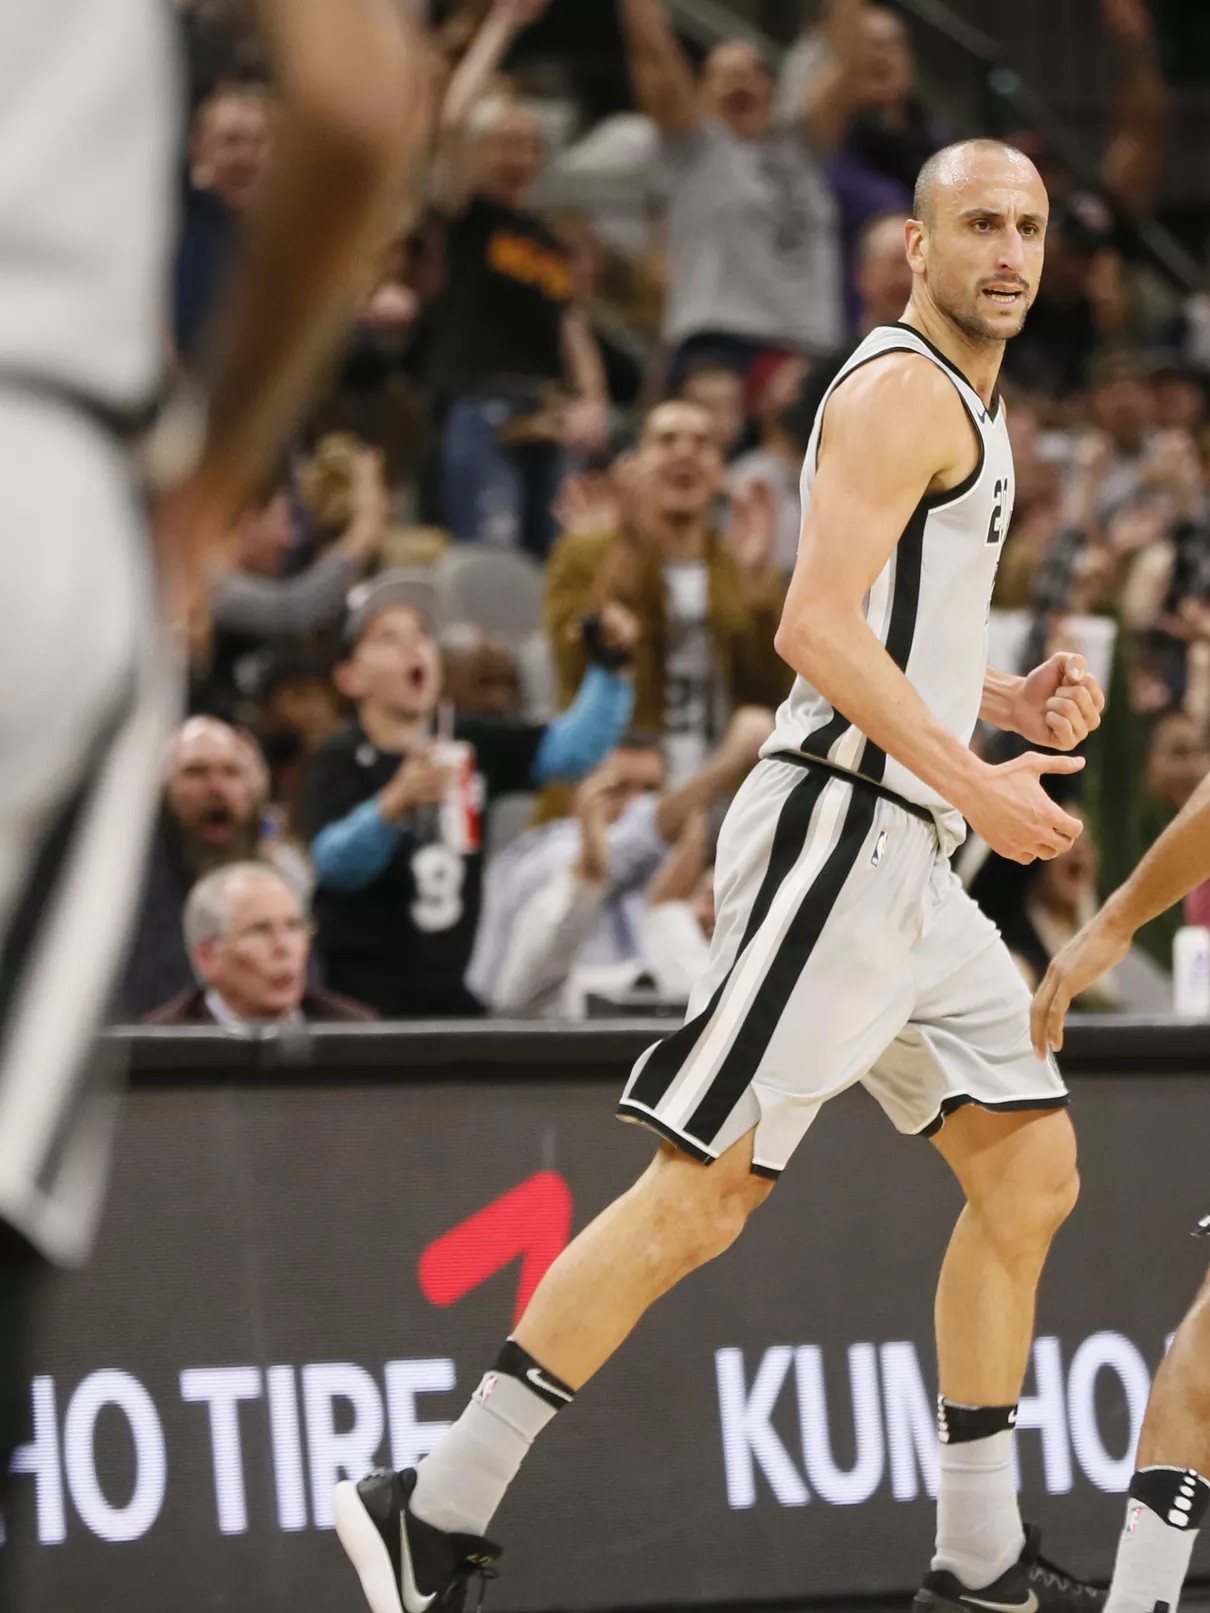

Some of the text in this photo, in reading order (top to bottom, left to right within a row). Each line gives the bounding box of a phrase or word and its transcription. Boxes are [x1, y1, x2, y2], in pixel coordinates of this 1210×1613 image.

[985, 476, 1009, 546] 2
[411, 844, 466, 932] 9
[0, 1358, 456, 1546] HO TIRE
